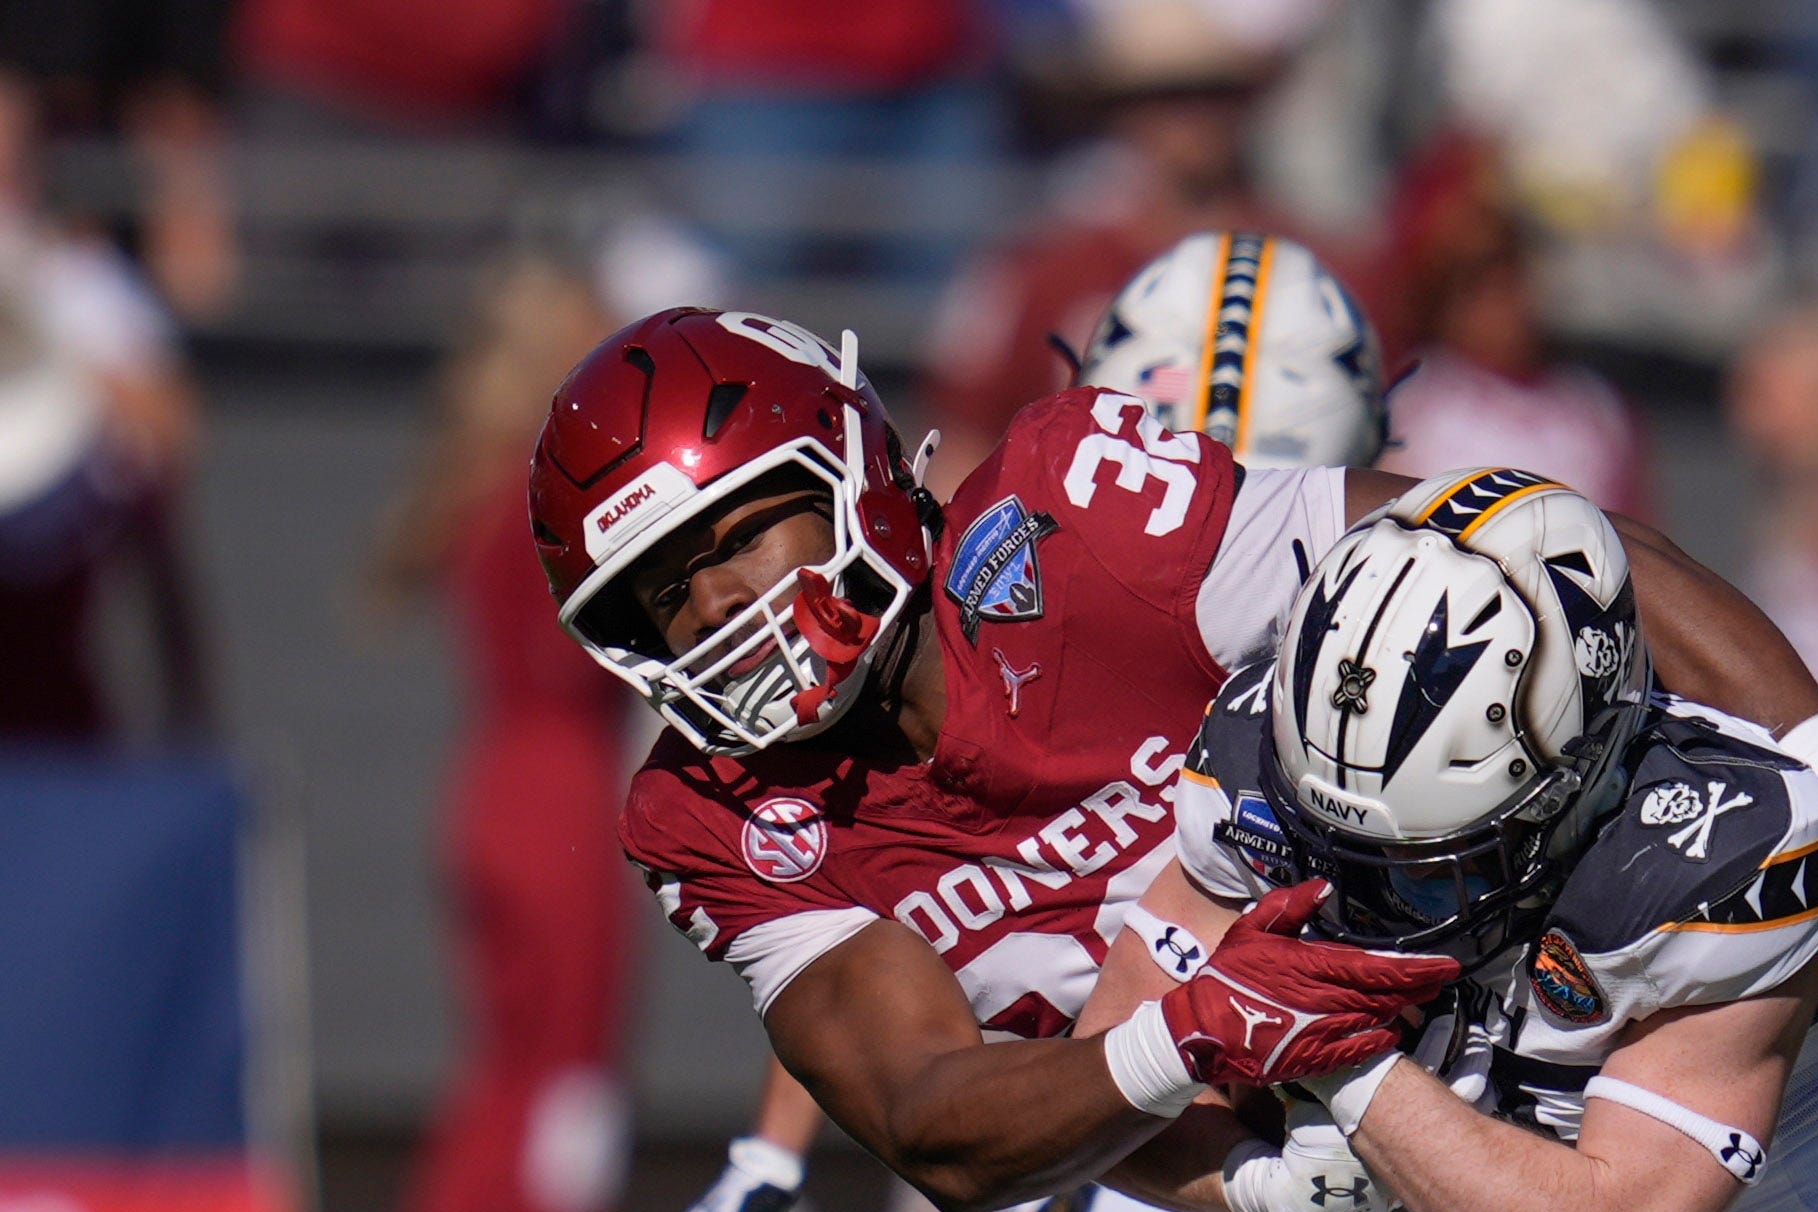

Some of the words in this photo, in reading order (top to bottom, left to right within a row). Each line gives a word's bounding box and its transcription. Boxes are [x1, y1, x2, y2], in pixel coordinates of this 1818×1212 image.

[1063, 391, 1201, 537] 32
[596, 482, 656, 534] OKLAHOMA
[964, 567, 993, 621] ARMED
[987, 516, 1040, 571] FORCES
[748, 803, 821, 876] SEC
[1225, 825, 1278, 853] ARMED
[1310, 788, 1368, 826] NAVY
[893, 735, 1187, 957] OONERS
